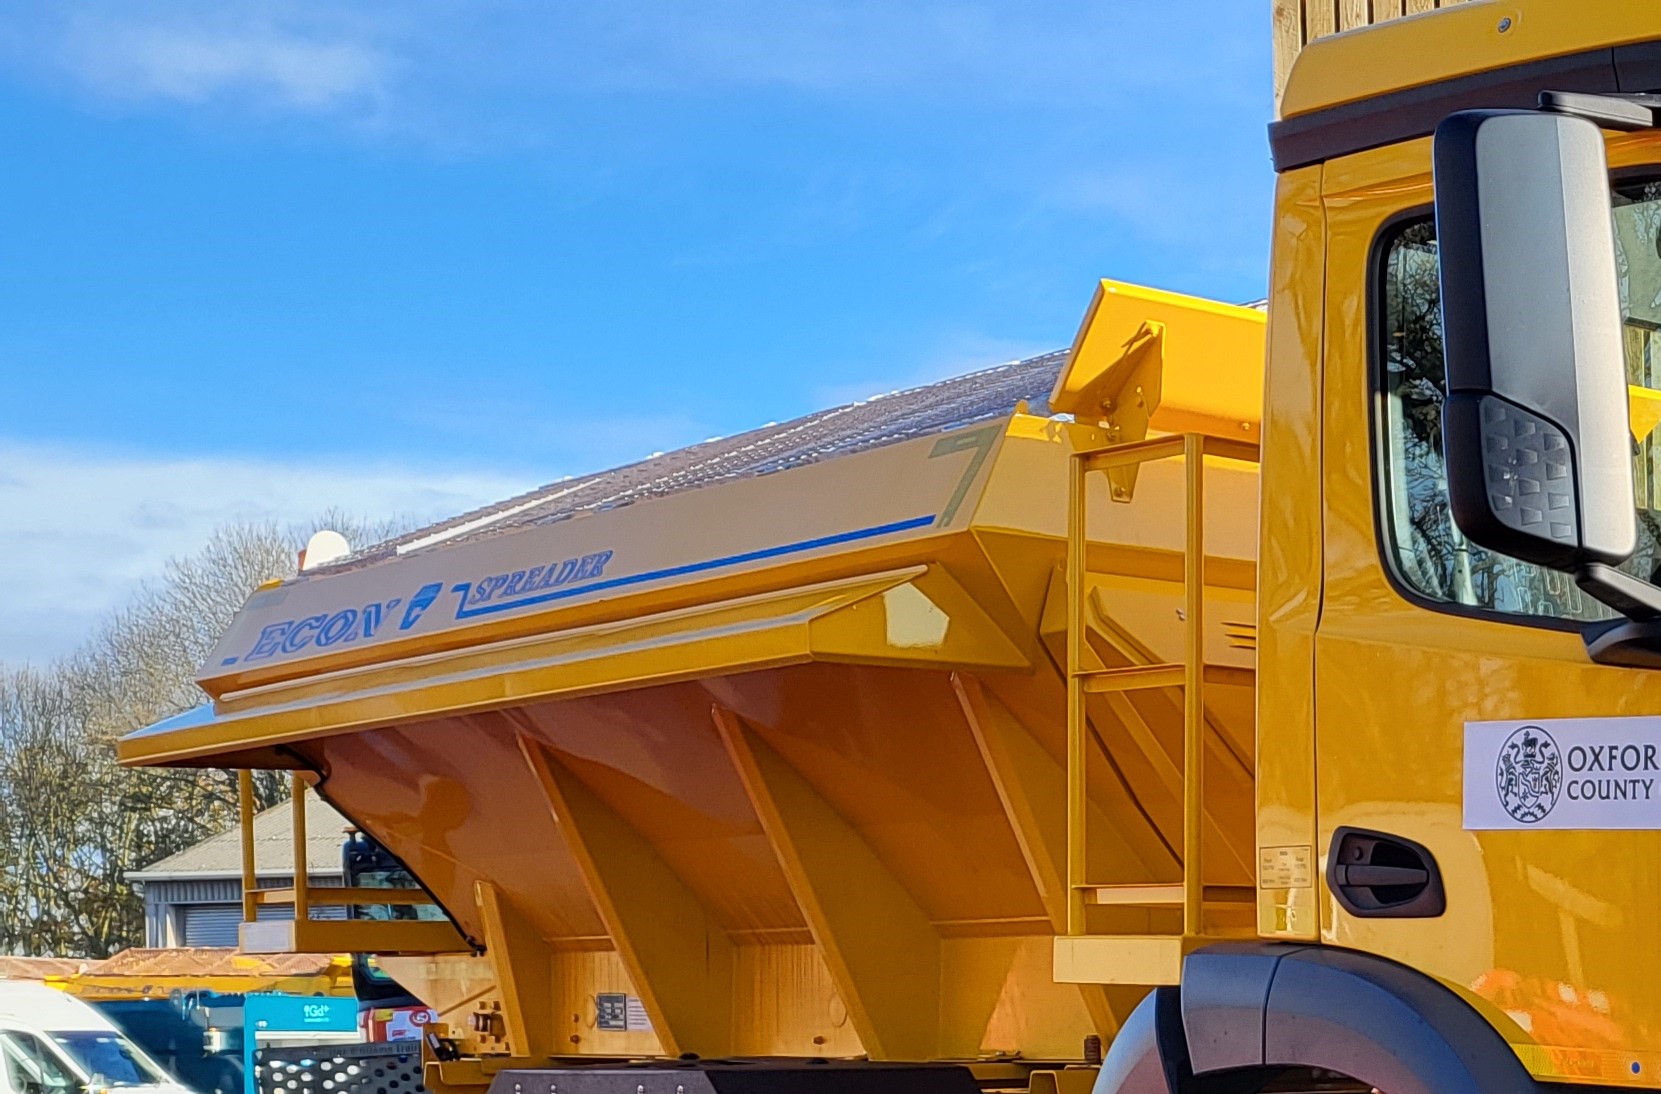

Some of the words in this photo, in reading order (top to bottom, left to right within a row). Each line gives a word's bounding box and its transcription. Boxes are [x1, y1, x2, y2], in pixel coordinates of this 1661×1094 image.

[472, 550, 614, 605] SPREADER
[245, 598, 402, 662] ECON
[1566, 778, 1655, 801] COUNTY
